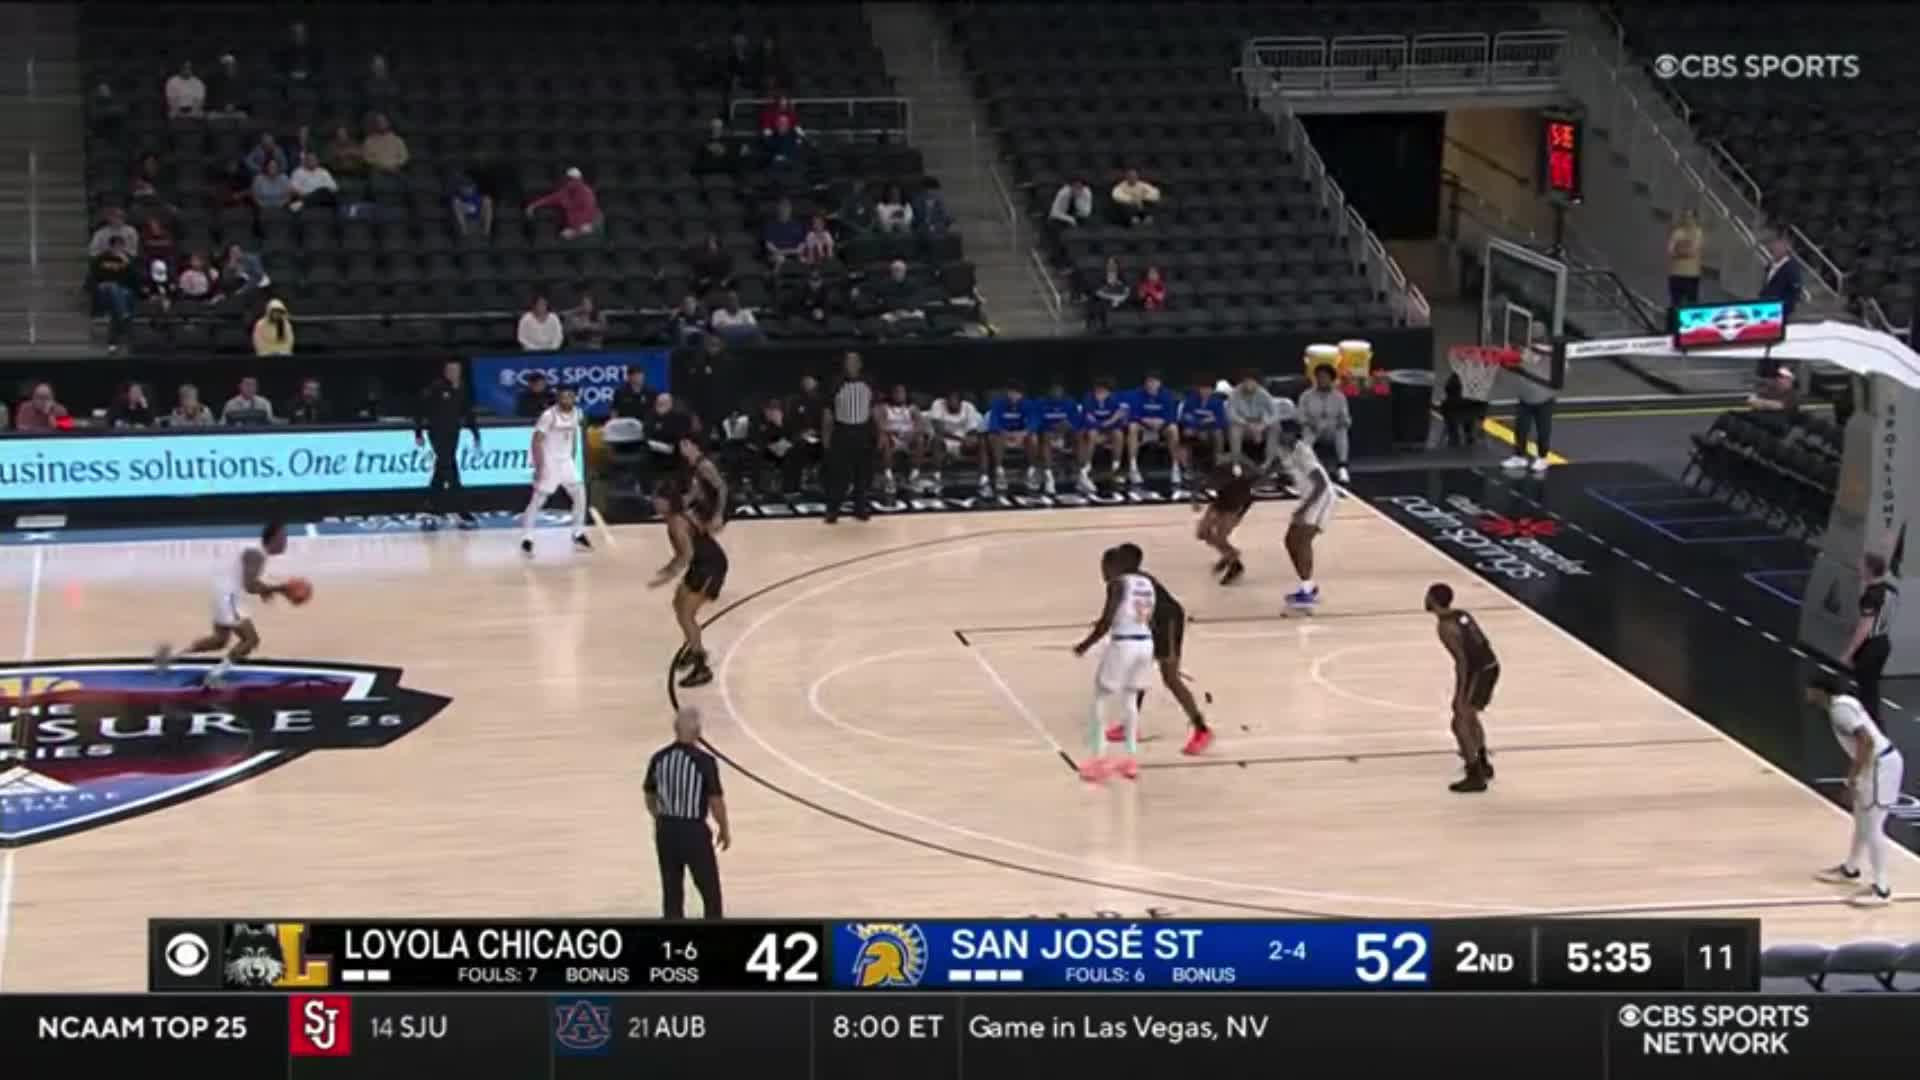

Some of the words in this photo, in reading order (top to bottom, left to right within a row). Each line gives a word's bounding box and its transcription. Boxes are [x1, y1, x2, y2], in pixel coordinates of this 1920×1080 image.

[128, 449, 283, 482] solutions.
[288, 448, 348, 477] One
[353, 450, 433, 474] truste
